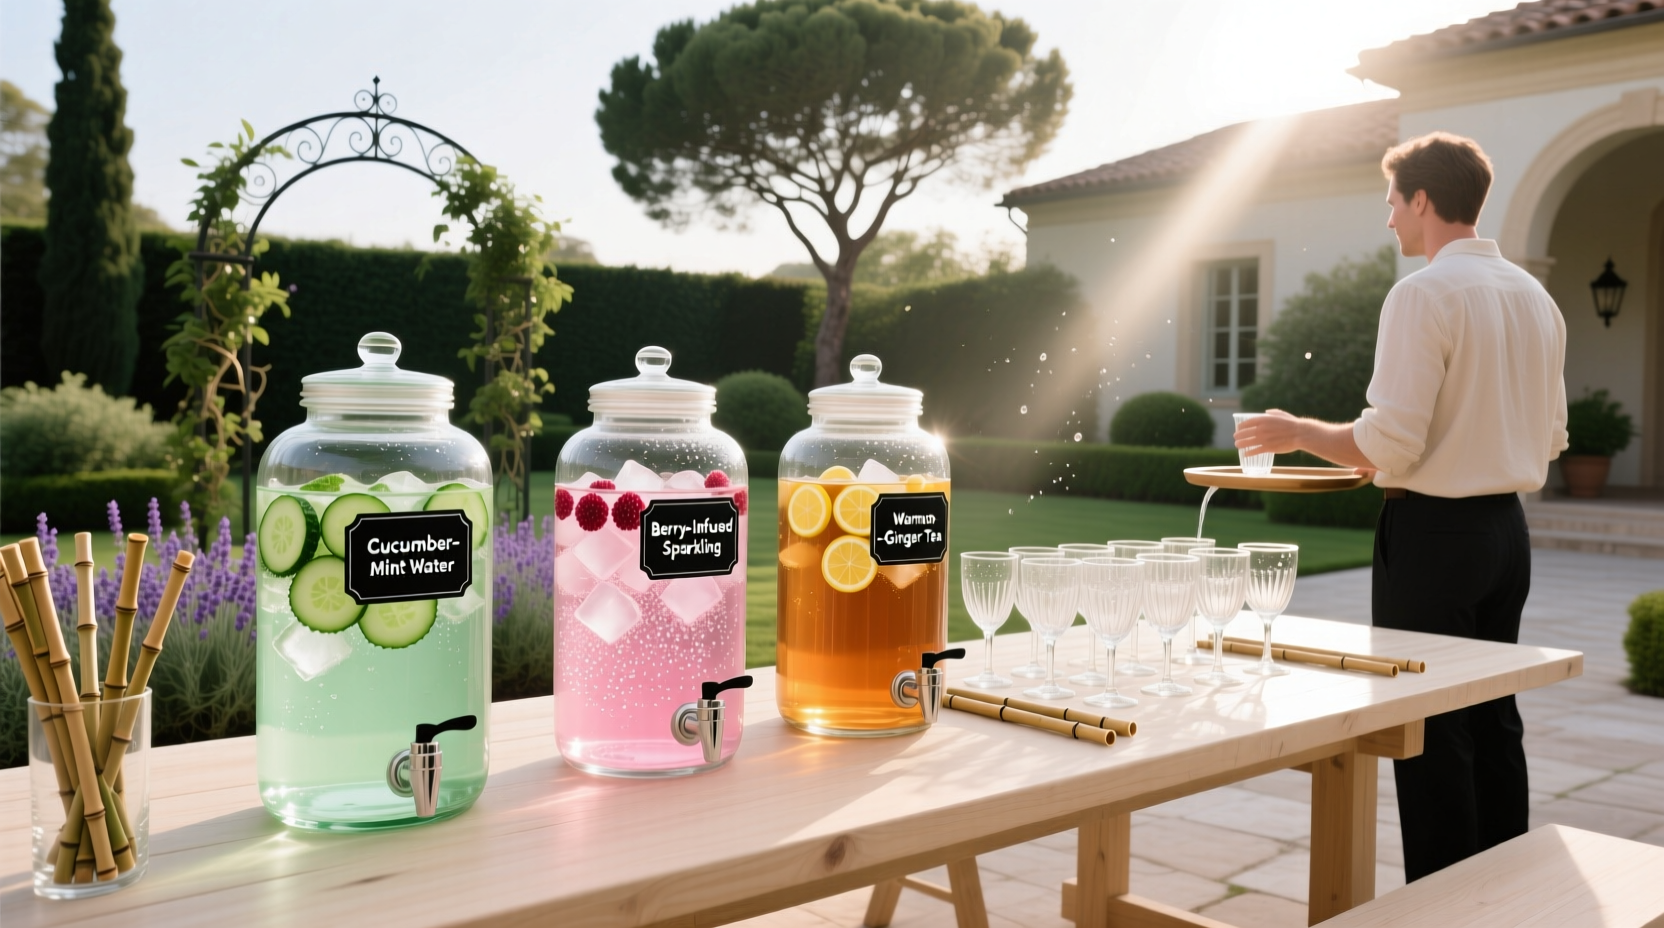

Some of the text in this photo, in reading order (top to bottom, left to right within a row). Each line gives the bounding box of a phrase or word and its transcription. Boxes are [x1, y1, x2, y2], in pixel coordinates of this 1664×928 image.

[367, 534, 460, 554] Cucumber-
[924, 529, 942, 543] Tea
[662, 539, 721, 560] Sparkling
[370, 558, 455, 576] Mint Water
